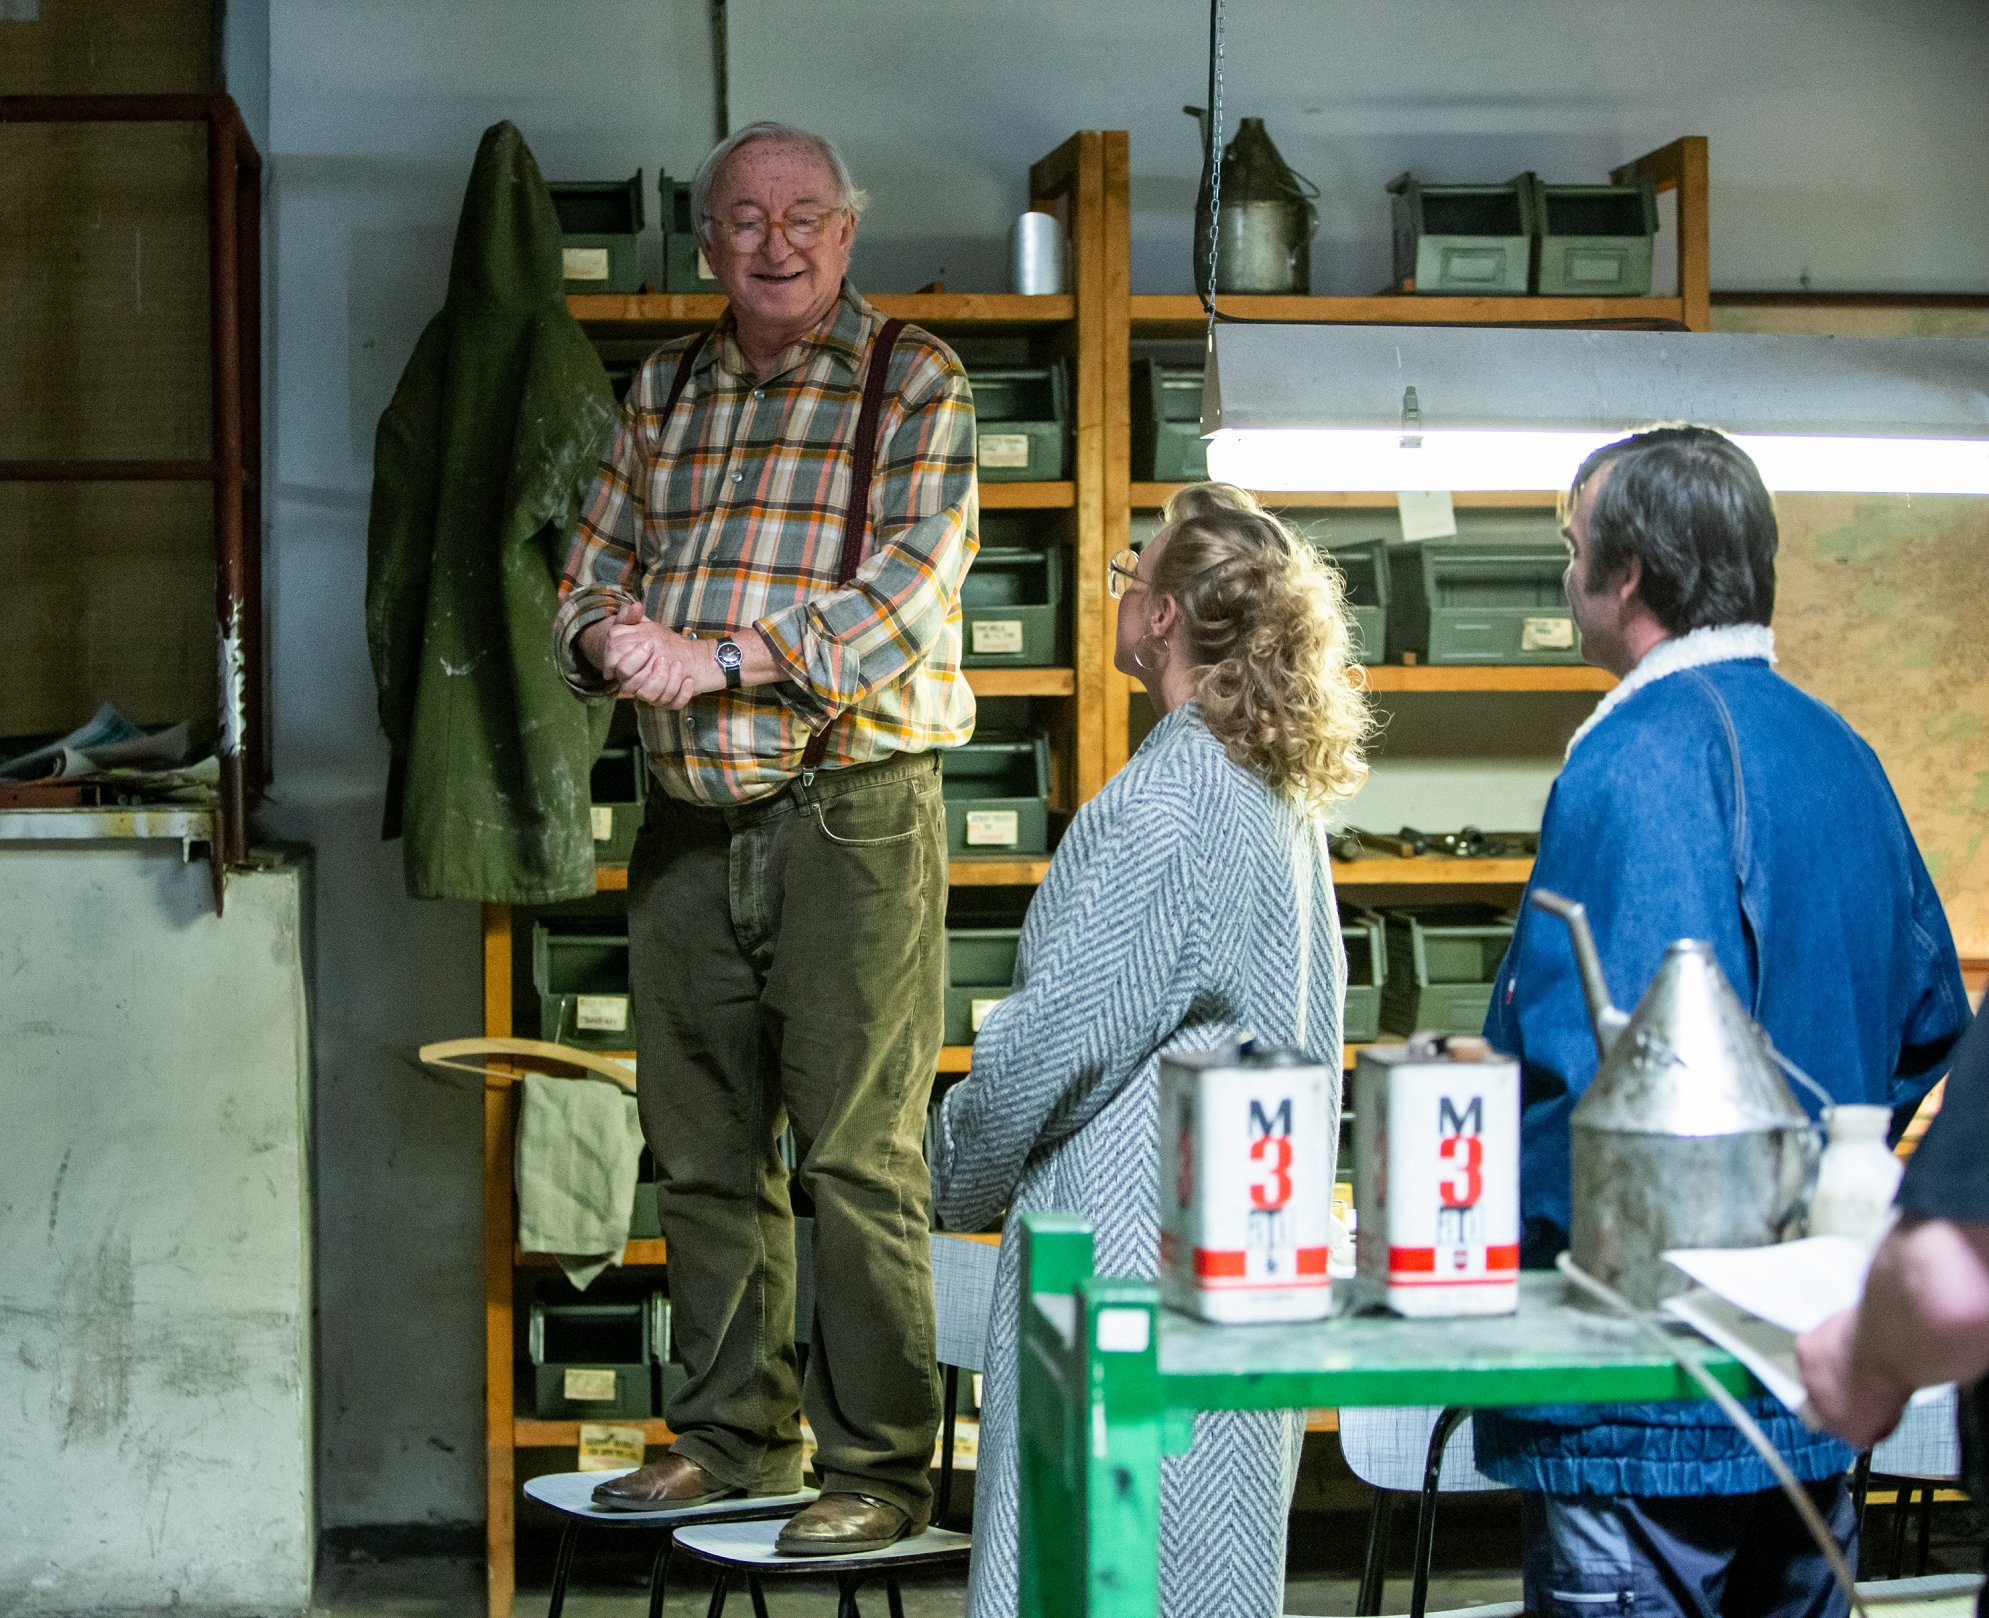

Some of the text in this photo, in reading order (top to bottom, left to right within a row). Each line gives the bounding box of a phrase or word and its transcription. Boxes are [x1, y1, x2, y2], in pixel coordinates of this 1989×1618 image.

[1250, 1099, 1292, 1137] M
[1440, 1097, 1483, 1135] M
[1250, 1135, 1292, 1211] 3
[1439, 1134, 1483, 1208] 3
